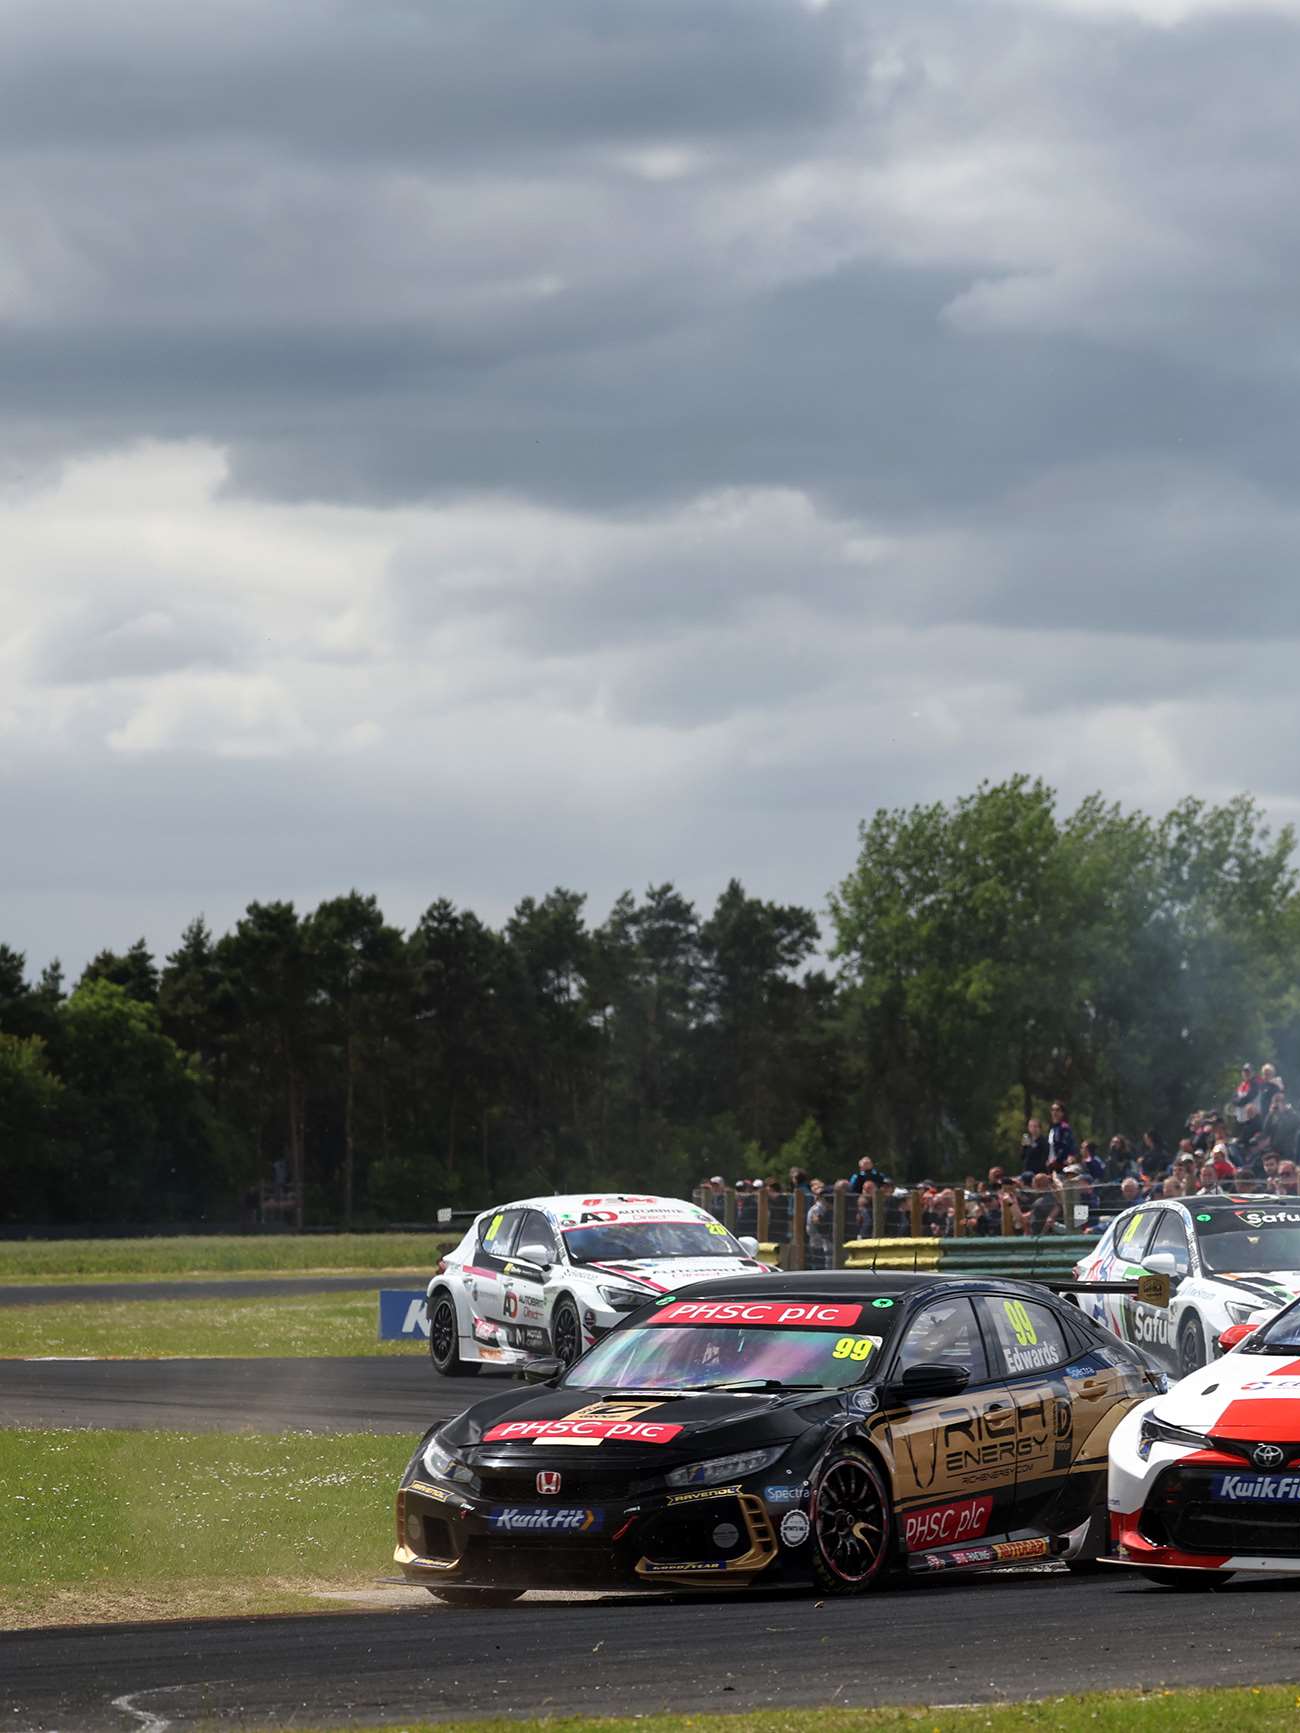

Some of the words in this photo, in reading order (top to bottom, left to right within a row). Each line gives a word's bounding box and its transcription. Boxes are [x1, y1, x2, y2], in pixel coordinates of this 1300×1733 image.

[668, 1303, 773, 1321] PHSC
[777, 1305, 840, 1323] plc
[1003, 1299, 1038, 1346] 99
[1134, 1306, 1168, 1345] Safu
[832, 1337, 873, 1361] 99
[1002, 1341, 1059, 1374] Edwards
[499, 1421, 603, 1438] PHSC
[604, 1422, 665, 1439] plc
[945, 1433, 1049, 1472] ENERGY
[674, 1487, 736, 1502] RAVENOL
[767, 1487, 810, 1502] Spectra
[904, 1508, 955, 1546] PHSC
[954, 1501, 986, 1540] plc
[651, 1562, 720, 1571] GOODYEAR
